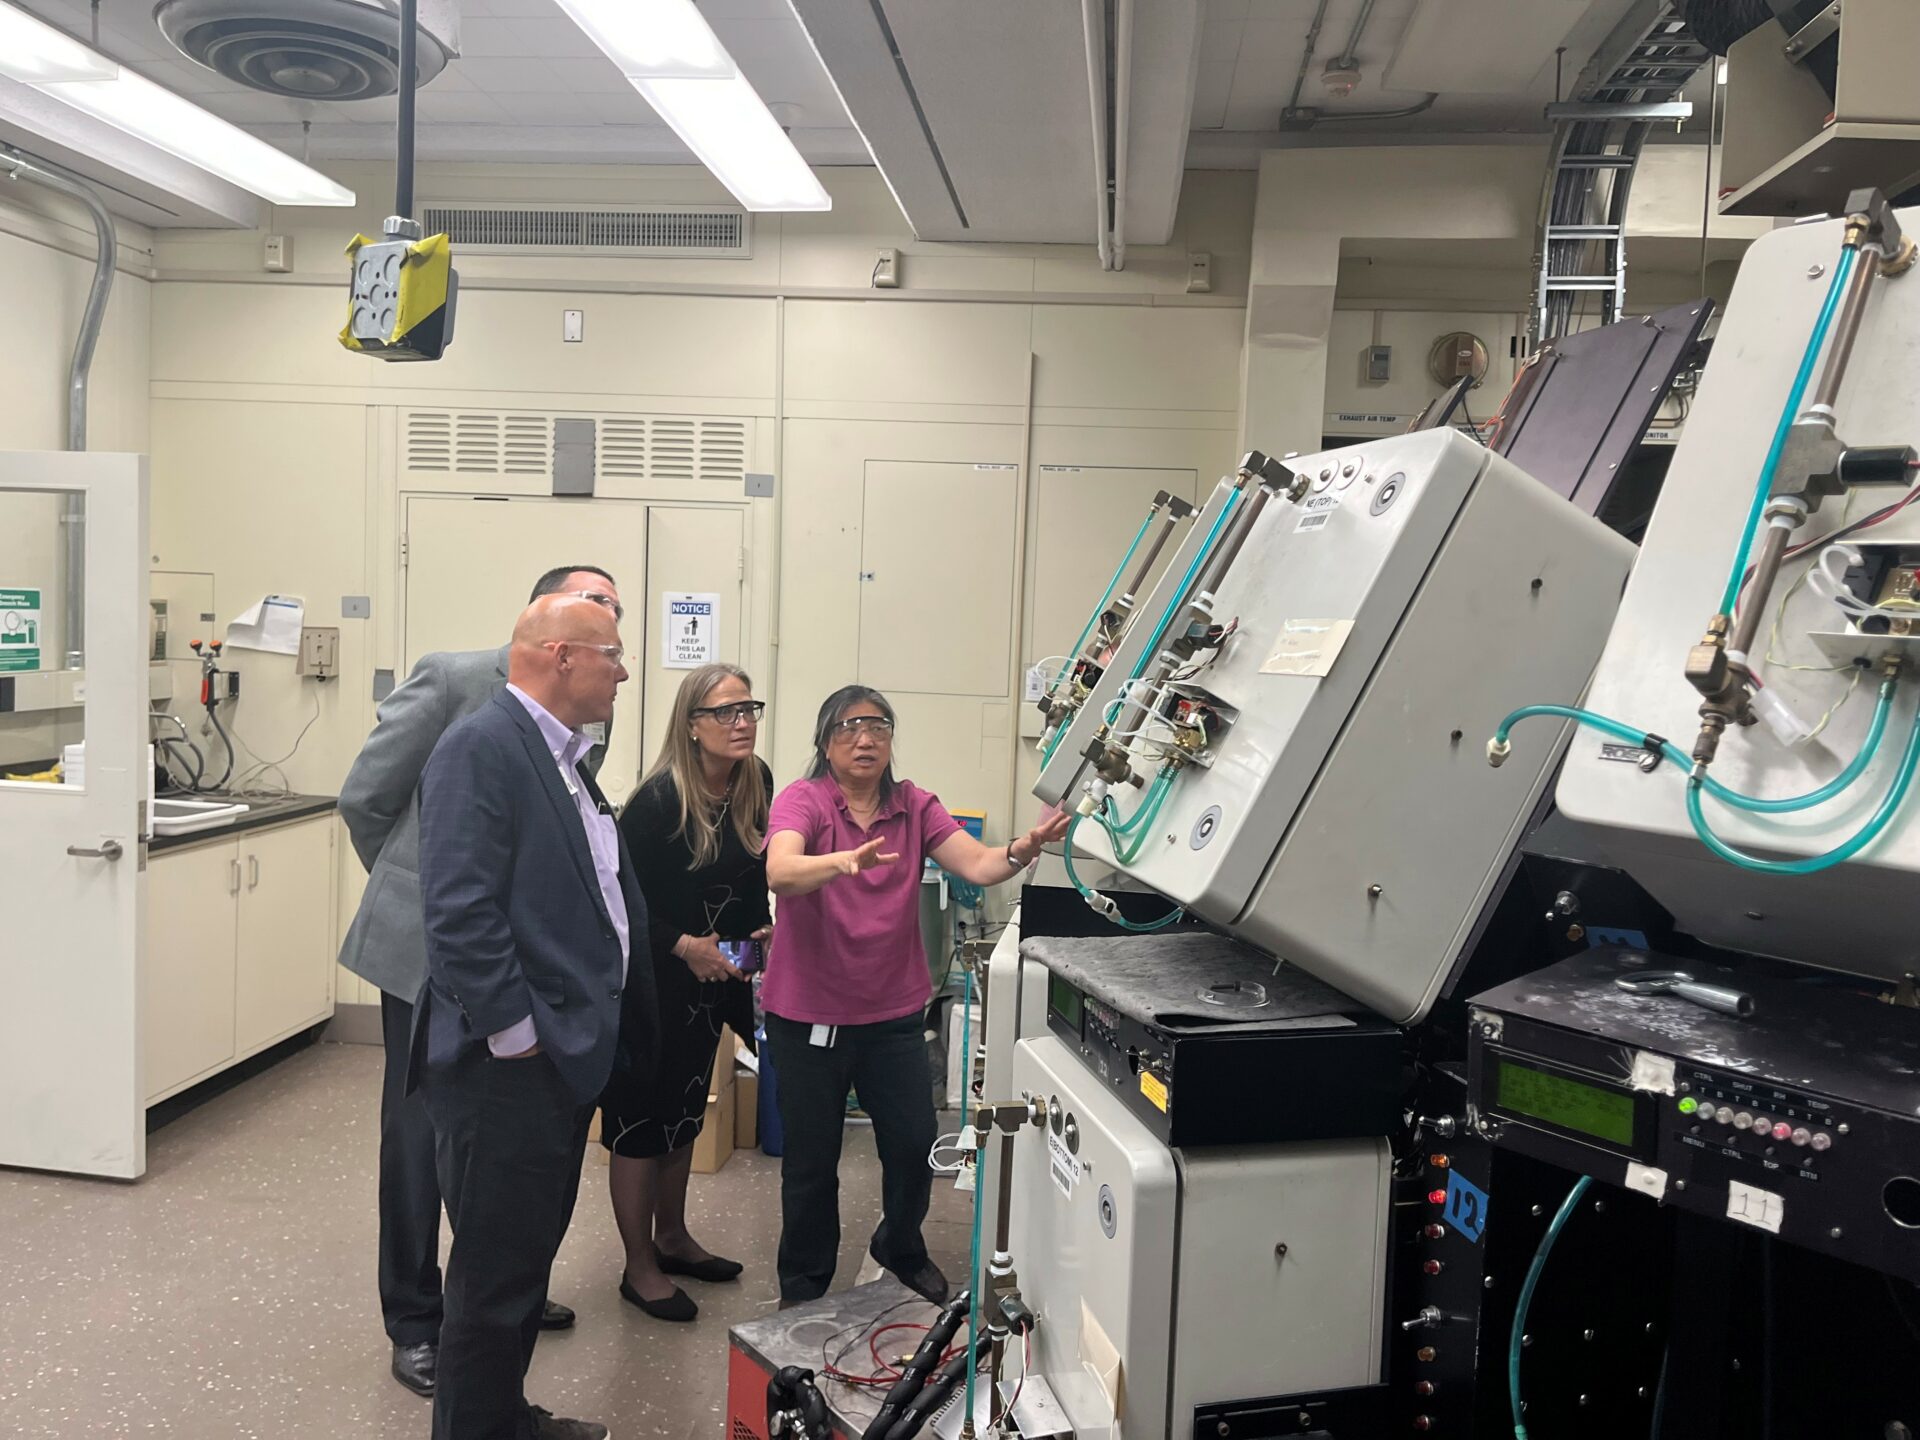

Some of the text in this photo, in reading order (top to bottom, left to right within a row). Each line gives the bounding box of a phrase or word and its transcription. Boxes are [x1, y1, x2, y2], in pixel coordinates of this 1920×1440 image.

[672, 604, 710, 614] NOTICE
[1683, 1136, 1817, 1180] MENU CTRL TOP BTM
[1452, 1187, 1481, 1235] 12
